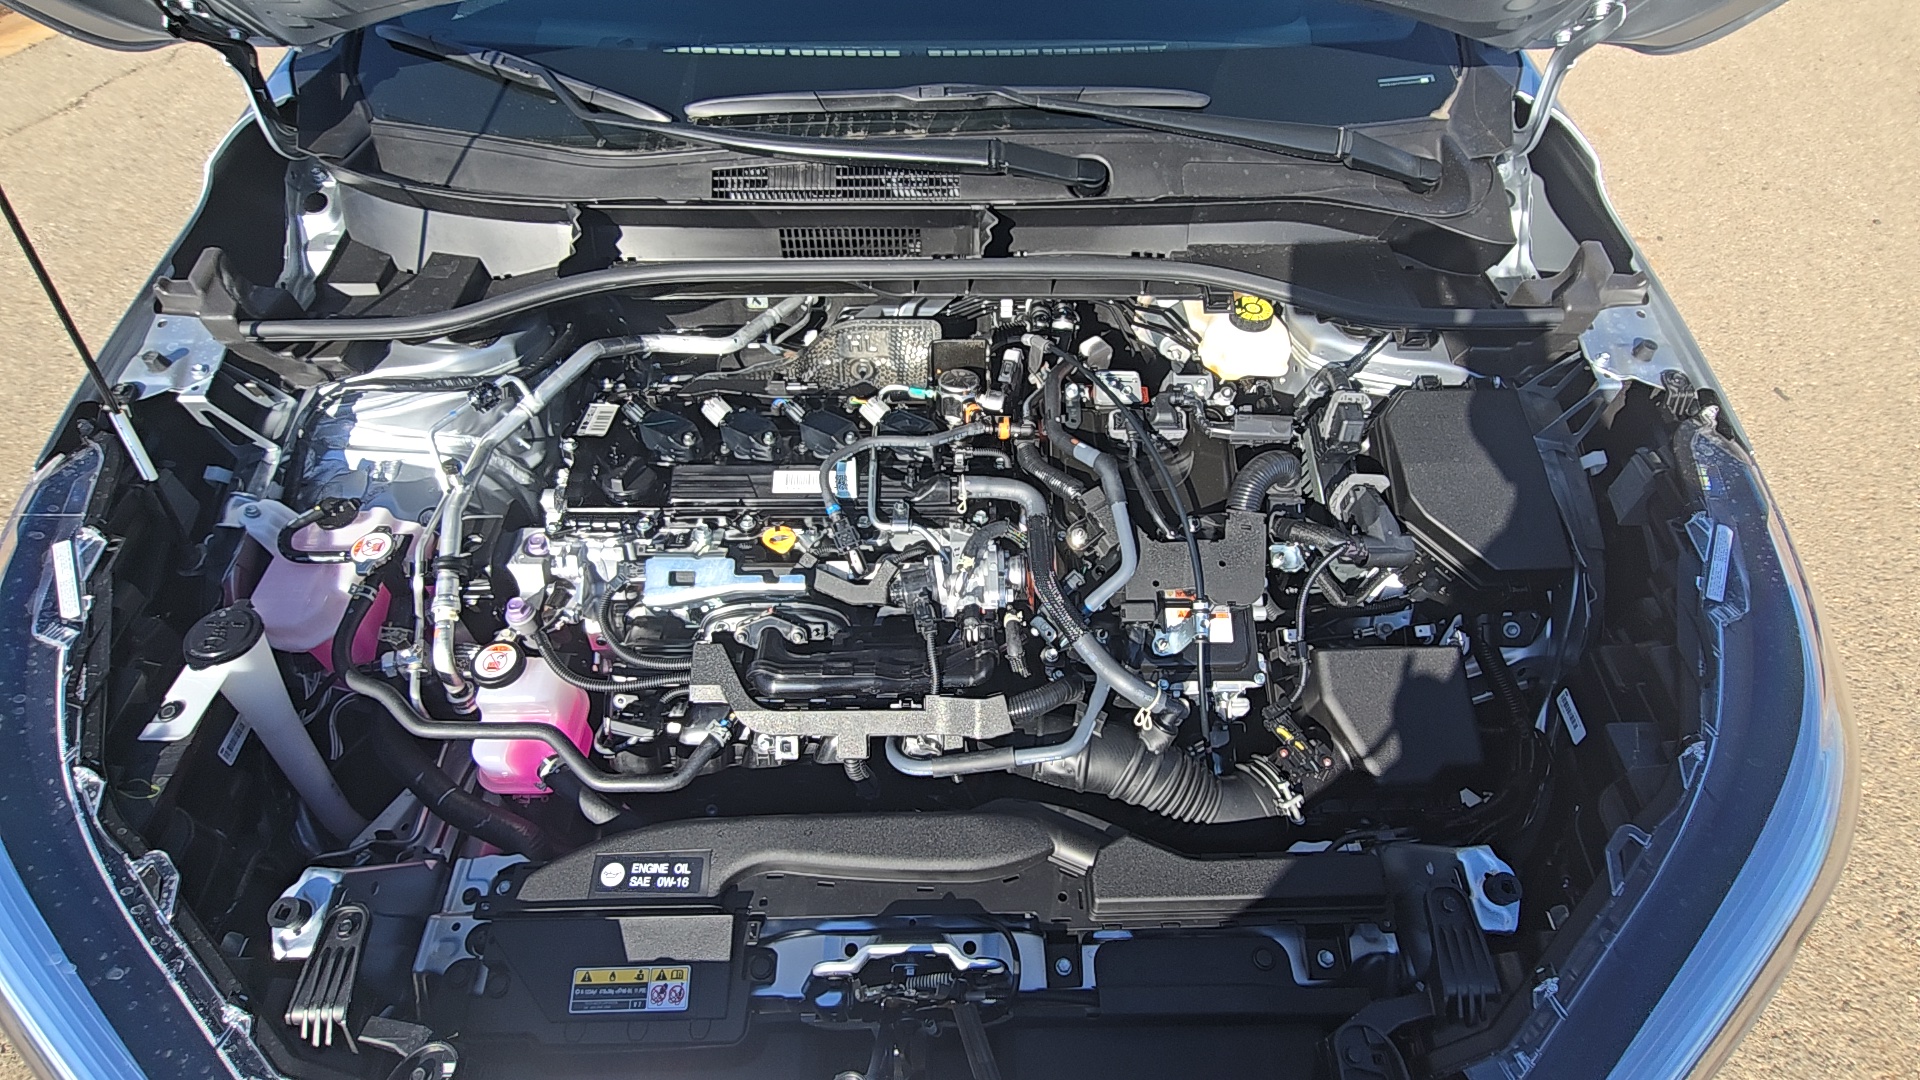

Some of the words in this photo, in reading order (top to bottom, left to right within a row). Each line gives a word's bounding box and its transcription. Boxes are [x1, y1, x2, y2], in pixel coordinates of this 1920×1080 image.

[631, 863, 669, 874] ENGINE
[673, 863, 691, 874] OIL
[629, 876, 651, 887] SAE
[656, 876, 690, 887] 0W-16
